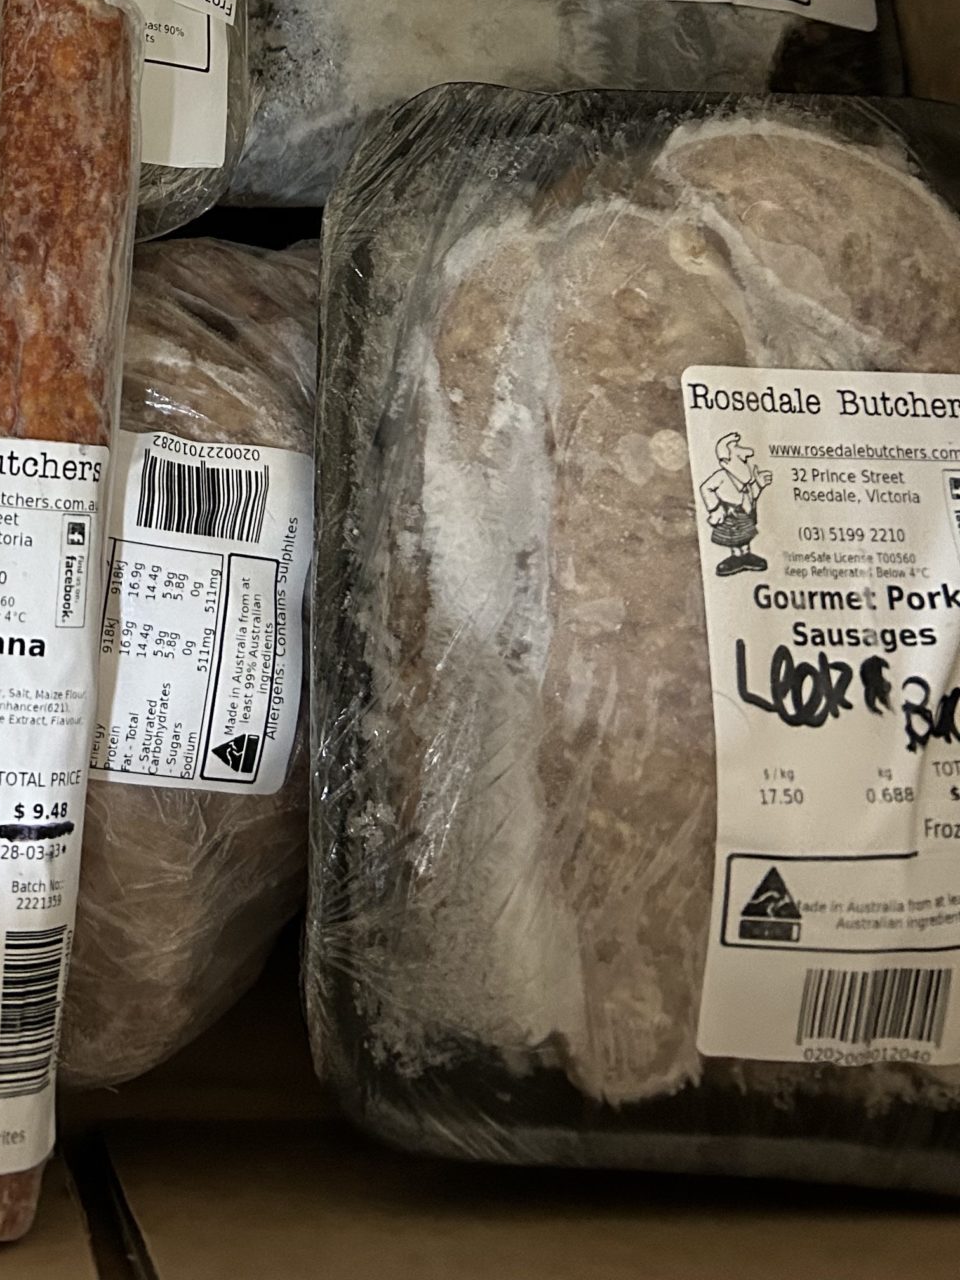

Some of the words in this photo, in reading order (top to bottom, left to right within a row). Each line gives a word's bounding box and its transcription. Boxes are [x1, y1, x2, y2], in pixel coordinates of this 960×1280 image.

[688, 383, 821, 414] Rosedale
[837, 390, 960, 419] Butcher
[152, 435, 260, 461] 0200227010282
[791, 469, 807, 482] 32
[812, 469, 856, 484] Prince
[862, 470, 904, 484] Street
[794, 487, 861, 504] Rosedale,
[868, 489, 920, 503] Victoria
[278, 517, 298, 584] Sulphites
[829, 527, 864, 541] 5199
[870, 528, 905, 542] 2210
[128, 562, 147, 598] 16.9g
[206, 568, 222, 614] 511mg
[242, 577, 250, 589] at
[754, 584, 877, 610] Gourmet
[887, 585, 960, 610] Pork
[137, 623, 153, 658] 14.4g
[146, 565, 162, 601] 14.4g
[239, 594, 249, 623] from
[275, 589, 286, 657] Contains
[119, 620, 138, 656] 16.9g
[249, 594, 261, 658] Australian
[793, 622, 937, 653] Sausages
[198, 627, 216, 672] 511mg
[232, 627, 246, 685] Australia
[257, 623, 273, 694] ingredients
[245, 662, 256, 691] 99%
[230, 688, 239, 700] in
[239, 695, 253, 723] least
[266, 664, 286, 740] Allergens:
[150, 681, 172, 776] Carbohydrates
[225, 703, 238, 735] Made
[168, 722, 182, 763] Sugars
[181, 731, 197, 778] Sodium
[51, 769, 81, 785] PRICE
[14, 803, 25, 819] $
[33, 802, 67, 818] 9.48
[760, 789, 804, 805] 17.50
